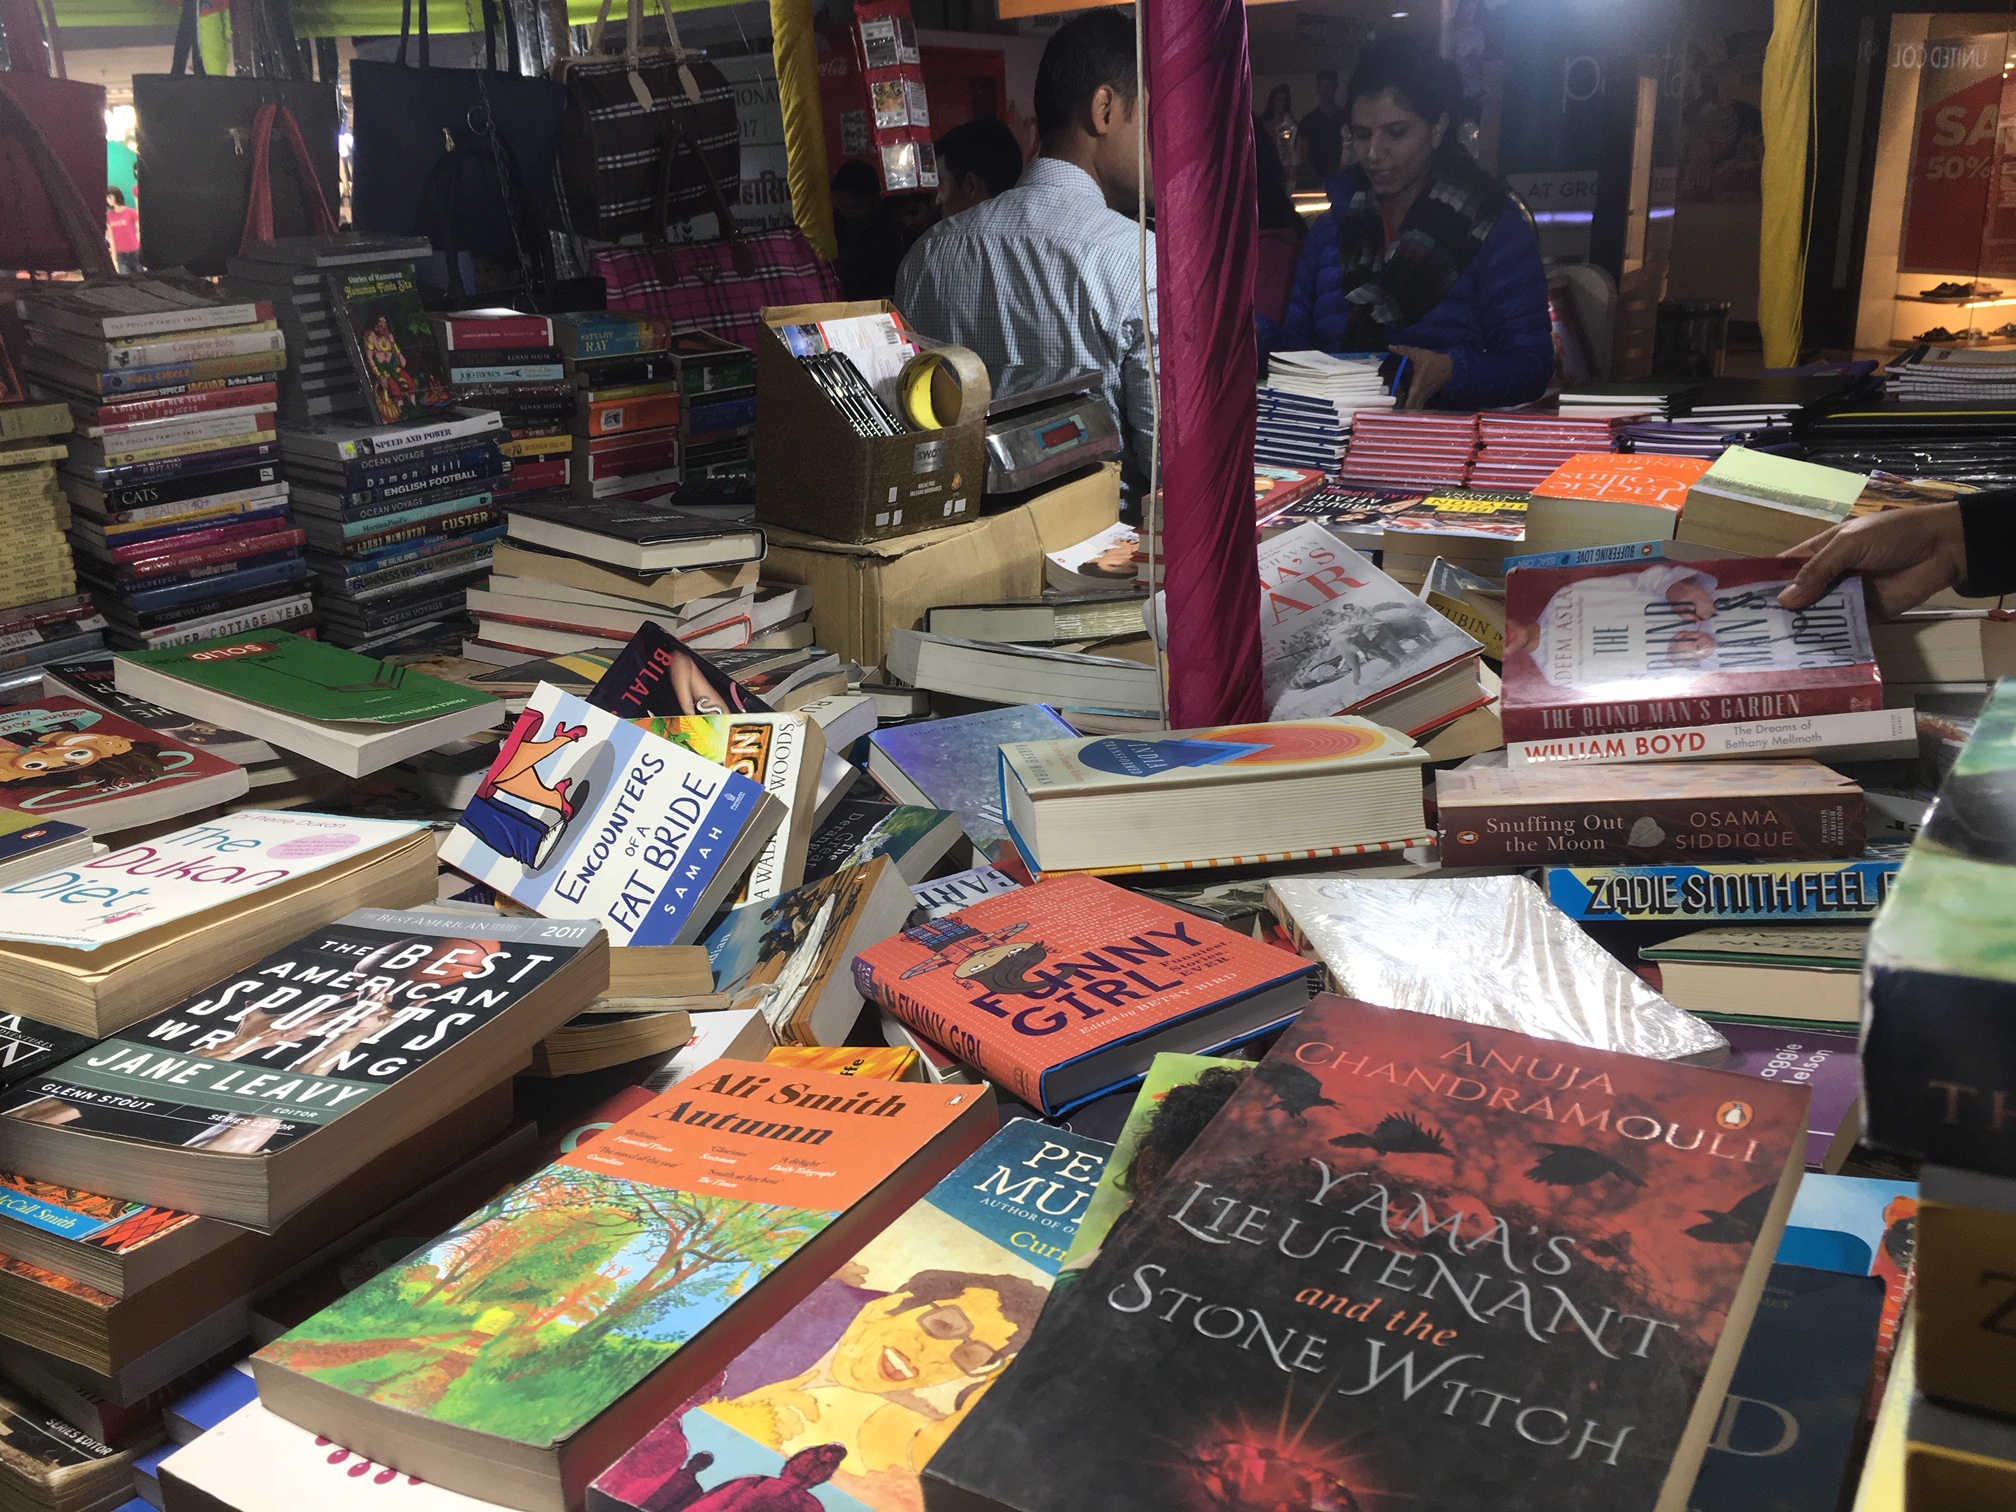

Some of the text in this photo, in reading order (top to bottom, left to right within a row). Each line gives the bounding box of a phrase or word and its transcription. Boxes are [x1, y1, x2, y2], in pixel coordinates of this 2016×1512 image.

[585, 340, 609, 352] RAY
[187, 379, 226, 393] JAGUAR
[375, 428, 452, 450] SPEED AND POWER
[361, 450, 425, 469] OCEAN VOYAGE
[366, 459, 461, 488] Damon Hill
[122, 488, 158, 505] CATS
[384, 470, 478, 497] ENGLISH FOOTBALL
[1548, 482, 1673, 501] Jackie
[1557, 471, 1687, 492] Collins
[359, 497, 424, 518] OCEAN VOYAGE
[441, 511, 489, 531] CUSTER
[1576, 545, 1635, 564] BUFFERING LOVE
[209, 602, 310, 640] COTTAGE YEAR
[382, 602, 444, 625] OCEAN VOYAGE
[1433, 603, 1491, 636] ZUBIN
[1591, 624, 1630, 657] THE
[619, 647, 673, 705] BILAL
[1540, 693, 1801, 731] THE BLIND MAN'S GARDEN
[1127, 742, 1169, 770] INDIA
[1524, 719, 1814, 765] WILLIAM BOYD The Dreams of
[1724, 730, 1823, 751] Bethany Mellmoth
[1102, 740, 1145, 776] TRANSFORMED
[1029, 764, 1056, 786] MOHAN
[754, 722, 795, 900] A WOODS
[1486, 813, 1625, 836] Snuffing Out
[163, 825, 263, 854] The
[554, 752, 665, 904] ENCOUNTERS
[624, 824, 652, 858] OF A
[1506, 834, 1606, 854] the Moon
[1675, 809, 1795, 851] OSAMA SIDDIQUE
[82, 845, 291, 887] Dukan
[606, 771, 717, 934] FAT BRIDE
[2, 870, 152, 908] Diet
[1586, 869, 1879, 914] ZADIE SMITH FEEL
[375, 913, 413, 925] BEST
[412, 916, 491, 931] AMERICAN
[539, 925, 588, 939] 2011
[319, 939, 556, 985] THE BEST
[970, 921, 1205, 1020] FUNNY
[1168, 949, 1230, 974] Stories.
[1178, 956, 1237, 978] EVER.
[258, 961, 510, 1009] AMERICAN
[184, 979, 476, 1051] SPORTS
[1011, 969, 1185, 1037] GIRL
[1079, 971, 1239, 1036] Edited by BETSY BIRD
[146, 1018, 410, 1078] WRITING
[898, 991, 989, 1073] FUNNY GIRL
[86, 1040, 374, 1109] JANE LEAVY
[1439, 1039, 1616, 1096] ANUJA
[40, 1082, 156, 1112] GLENN STOUT
[688, 1071, 909, 1119] Ali Smith
[1294, 1040, 1759, 1164] CHANDRAMOULI
[207, 1114, 297, 1132] SERIES EDITOR
[271, 1105, 320, 1119] EDITOR
[649, 1100, 835, 1147] Autumn
[585, 1153, 626, 1168] Guardian
[612, 1135, 675, 1154] Financial Times
[698, 1152, 738, 1166] Scotsman
[696, 1174, 740, 1190] The Times
[768, 1163, 794, 1175] Daily
[32, 1208, 79, 1230] Smith
[979, 1196, 1061, 1230] AUTHOR OF
[1304, 1156, 1578, 1277] YAMA'S
[1168, 1180, 1680, 1361] LIEUTENANT
[1294, 1283, 1459, 1349] and the
[1107, 1262, 1329, 1375] STONE
[1337, 1336, 1637, 1468] WITCH
[44, 1416, 114, 1457] SERIES EDITOR
